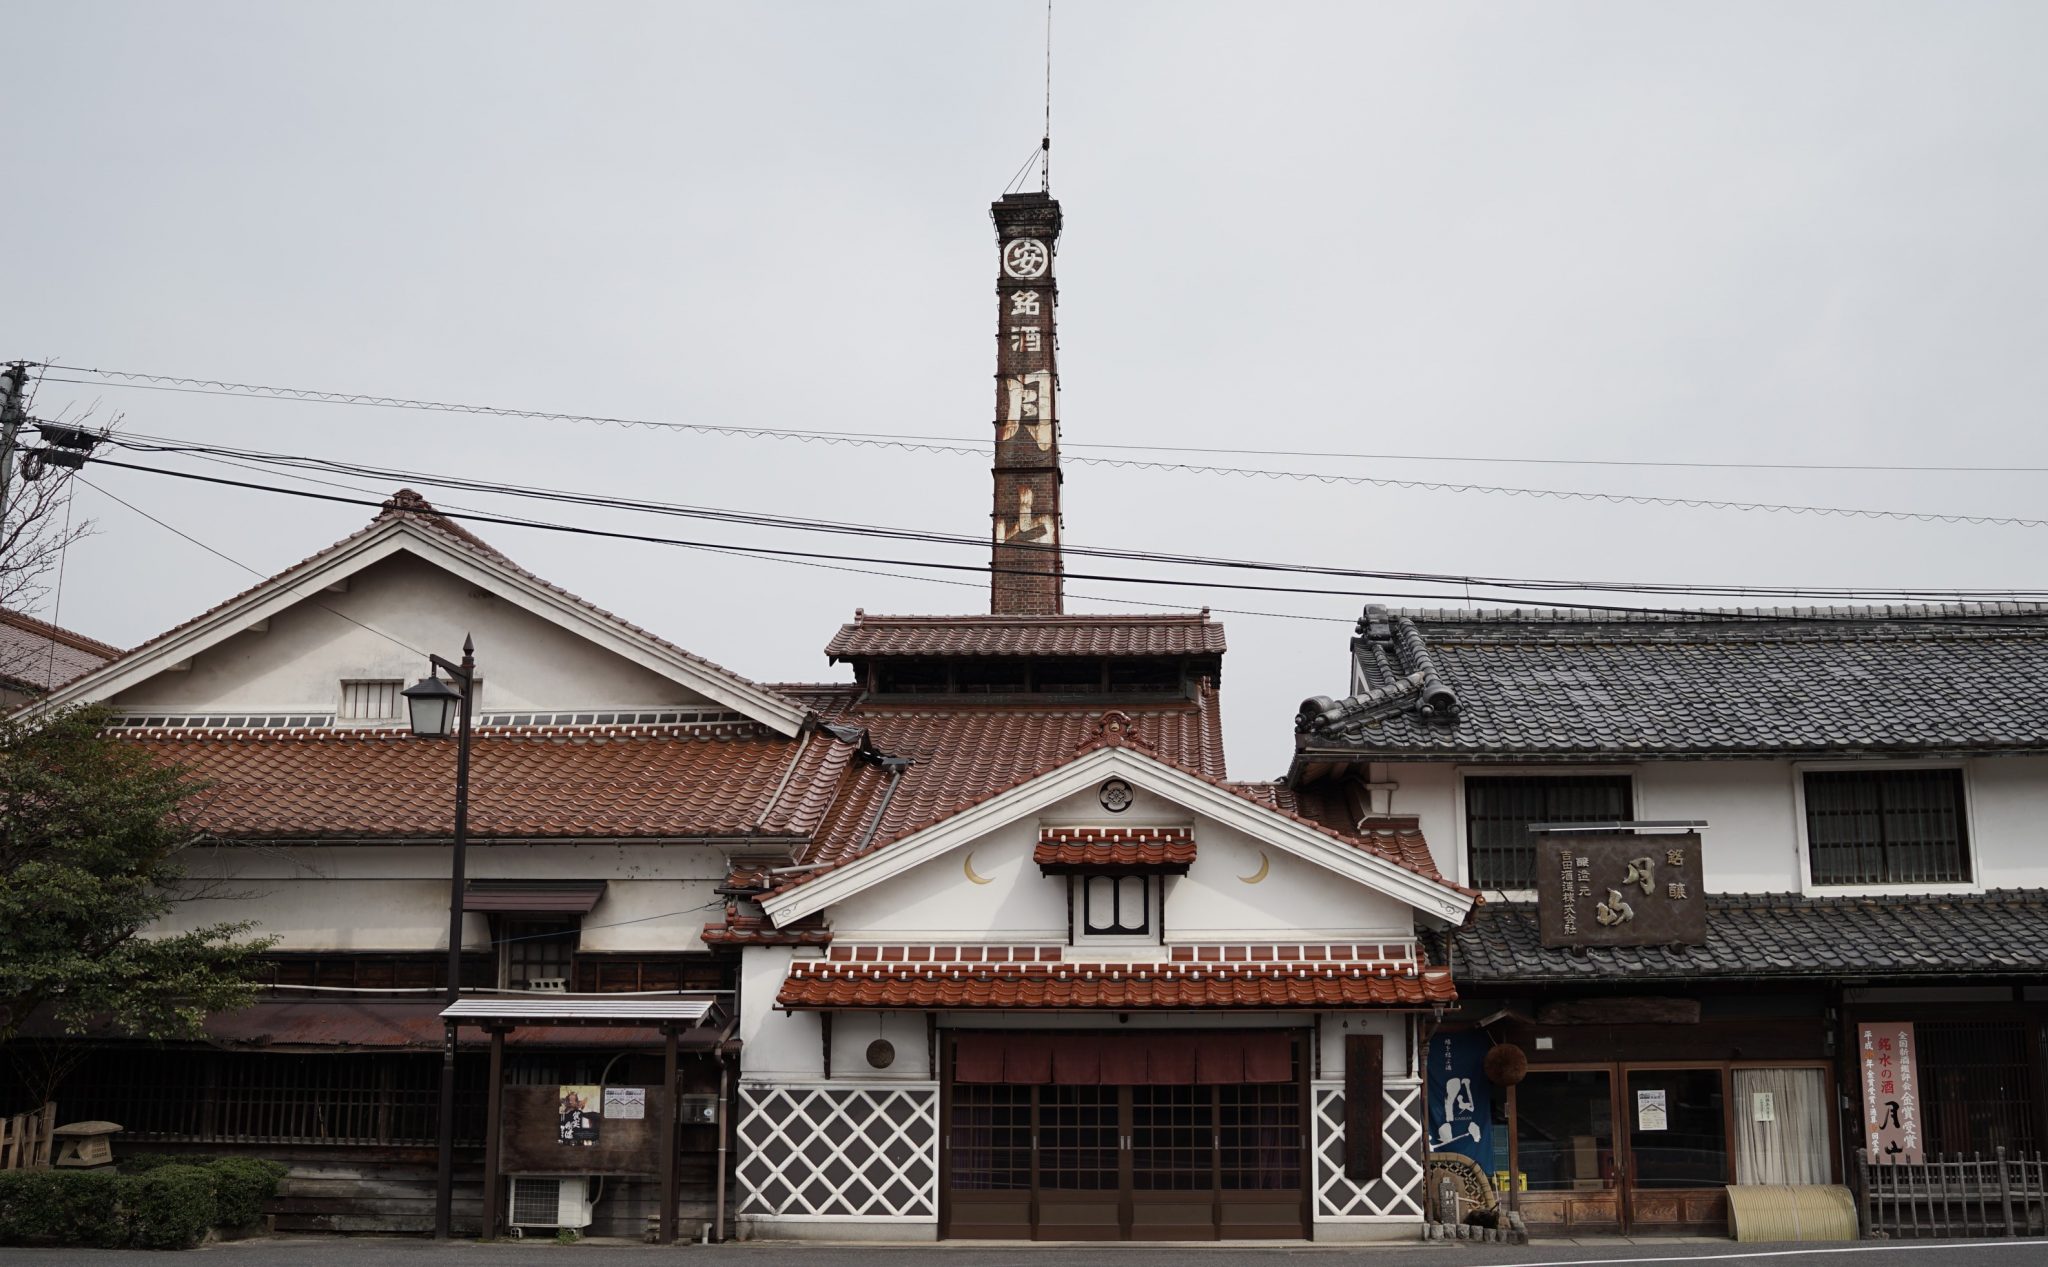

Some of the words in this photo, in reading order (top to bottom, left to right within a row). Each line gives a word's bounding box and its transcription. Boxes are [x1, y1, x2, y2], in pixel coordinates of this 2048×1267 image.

[1008, 240, 1045, 276] 安
[1010, 290, 1041, 352] 銘酒
[996, 369, 1056, 545] 月山
[1560, 850, 1577, 935] 吉田酒造株式会社
[1595, 857, 1656, 927] 月山
[1878, 1038, 1894, 1094] 銘水の酒
[1880, 1101, 1903, 1155] 月山
